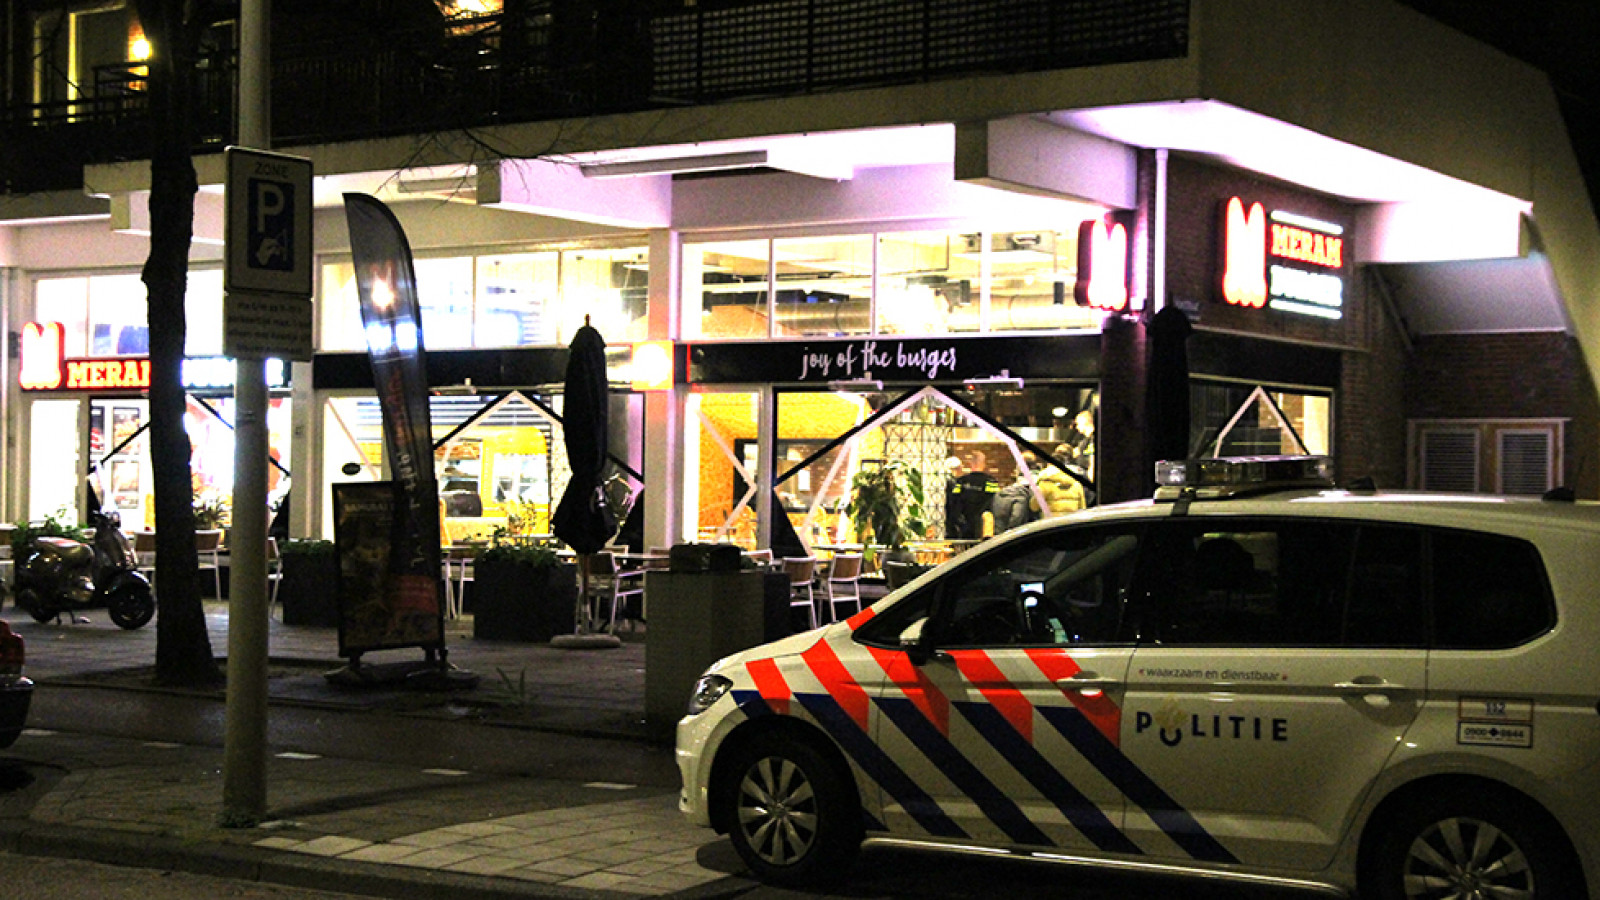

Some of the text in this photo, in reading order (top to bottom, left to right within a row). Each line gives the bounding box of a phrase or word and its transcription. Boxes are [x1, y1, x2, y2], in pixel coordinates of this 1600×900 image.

[255, 161, 289, 178] ZONE
[257, 184, 286, 232] P
[1270, 223, 1343, 268] MERAM
[66, 359, 151, 388] MERA
[798, 341, 957, 380] joy of the burger
[1205, 670, 1219, 680] en
[1136, 711, 1288, 747] POLITIE
